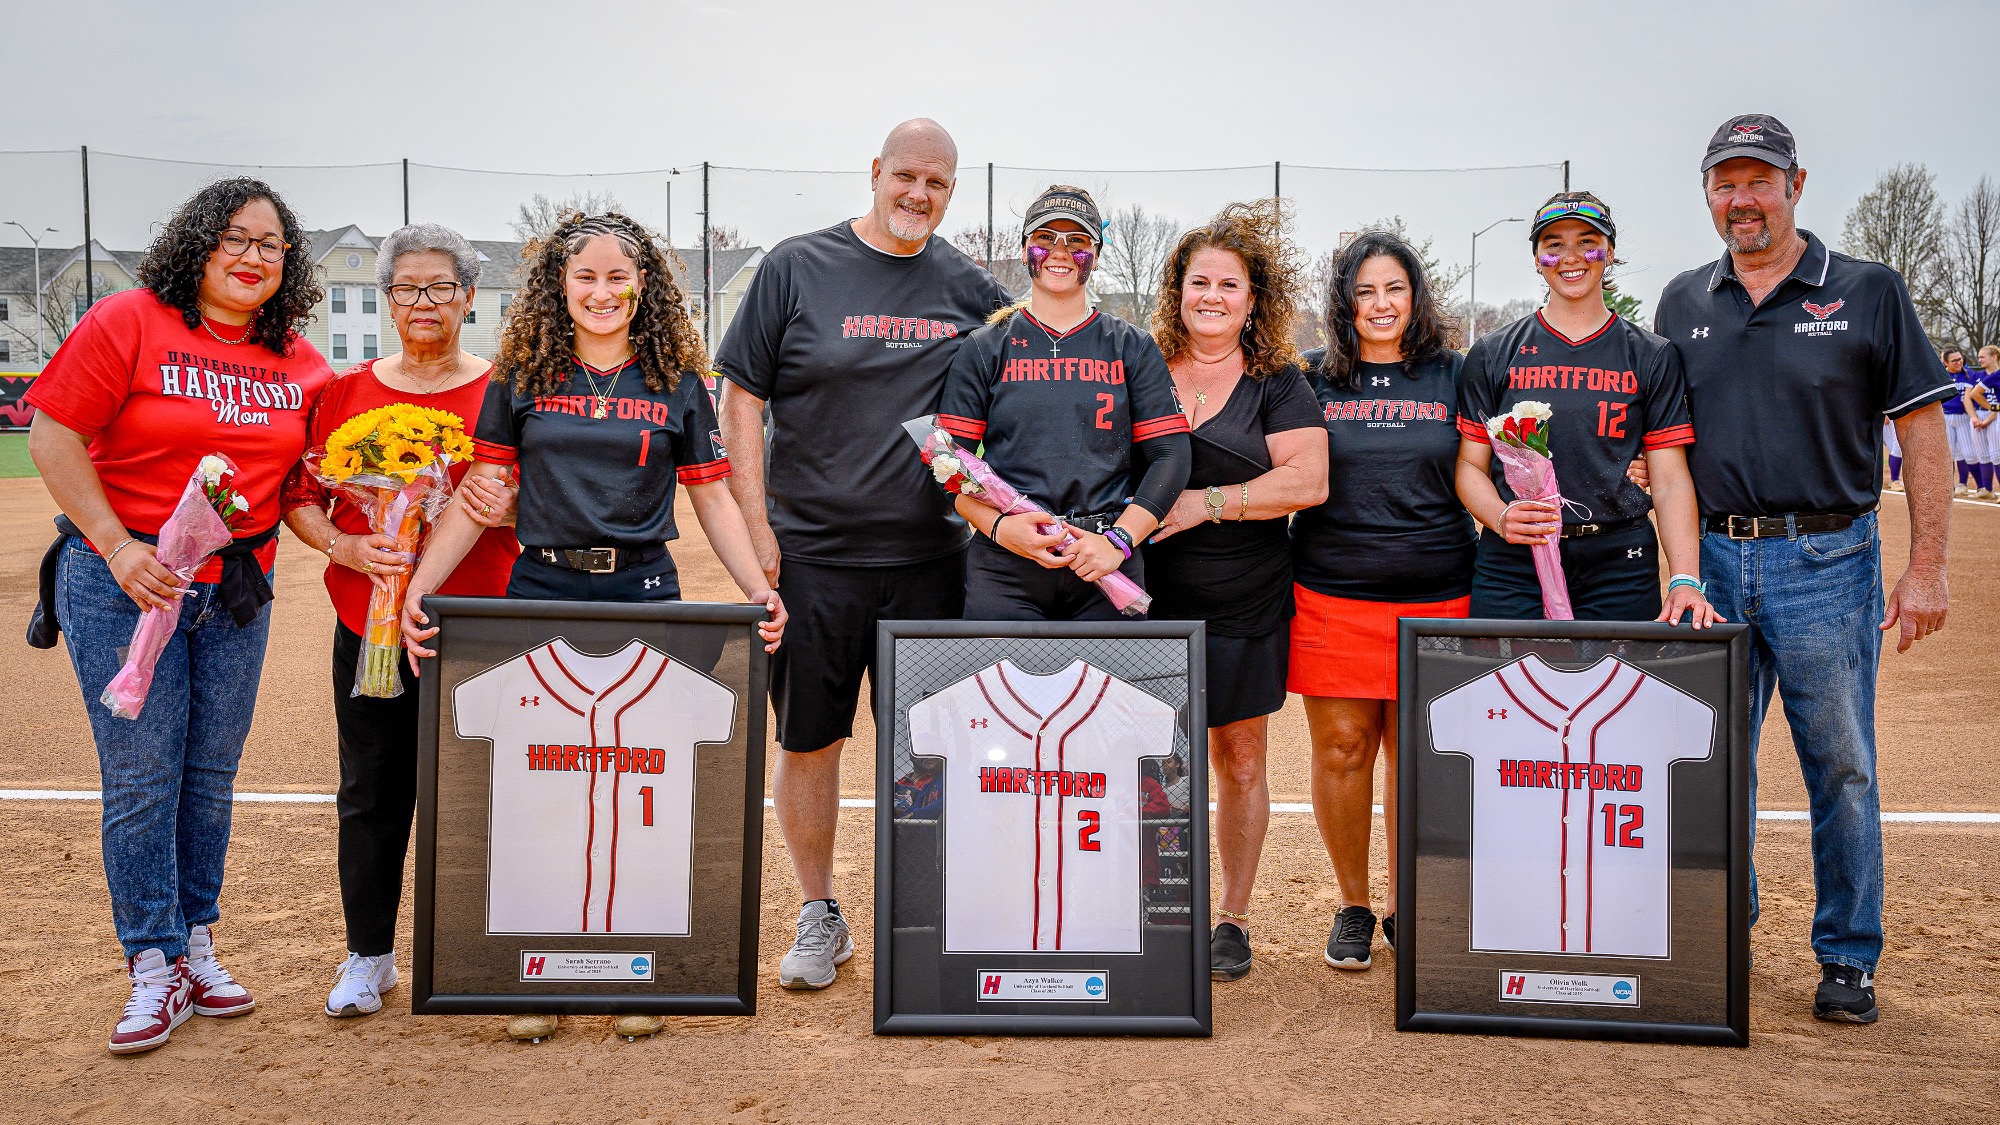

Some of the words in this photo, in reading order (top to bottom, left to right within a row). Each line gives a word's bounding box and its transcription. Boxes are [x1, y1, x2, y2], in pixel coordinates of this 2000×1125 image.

[1044, 198, 1087, 212] HARTFORD
[841, 315, 958, 340] HARTFORD
[1793, 320, 1848, 333] HARTFORD
[885, 341, 922, 349] SOFTBALL
[168, 351, 267, 380] UNIVERSITY
[272, 371, 288, 382] OF
[1002, 357, 1126, 385] HARTFORD
[1509, 366, 1638, 394] HARTFORD
[159, 364, 303, 410] HARTFORD
[211, 398, 270, 427] Mom
[534, 395, 669, 427] HARTFORD
[1095, 392, 1114, 430] 2
[1323, 399, 1447, 421] HARTFORD
[1597, 401, 1629, 438] 12
[638, 429, 651, 466] 1
[525, 744, 666, 774] HARTFORD
[978, 767, 1106, 798] HARTFORD
[1497, 759, 1643, 792] HARTFORD
[638, 786, 654, 827] 1
[1077, 810, 1101, 852] 2
[1601, 803, 1644, 849] 12
